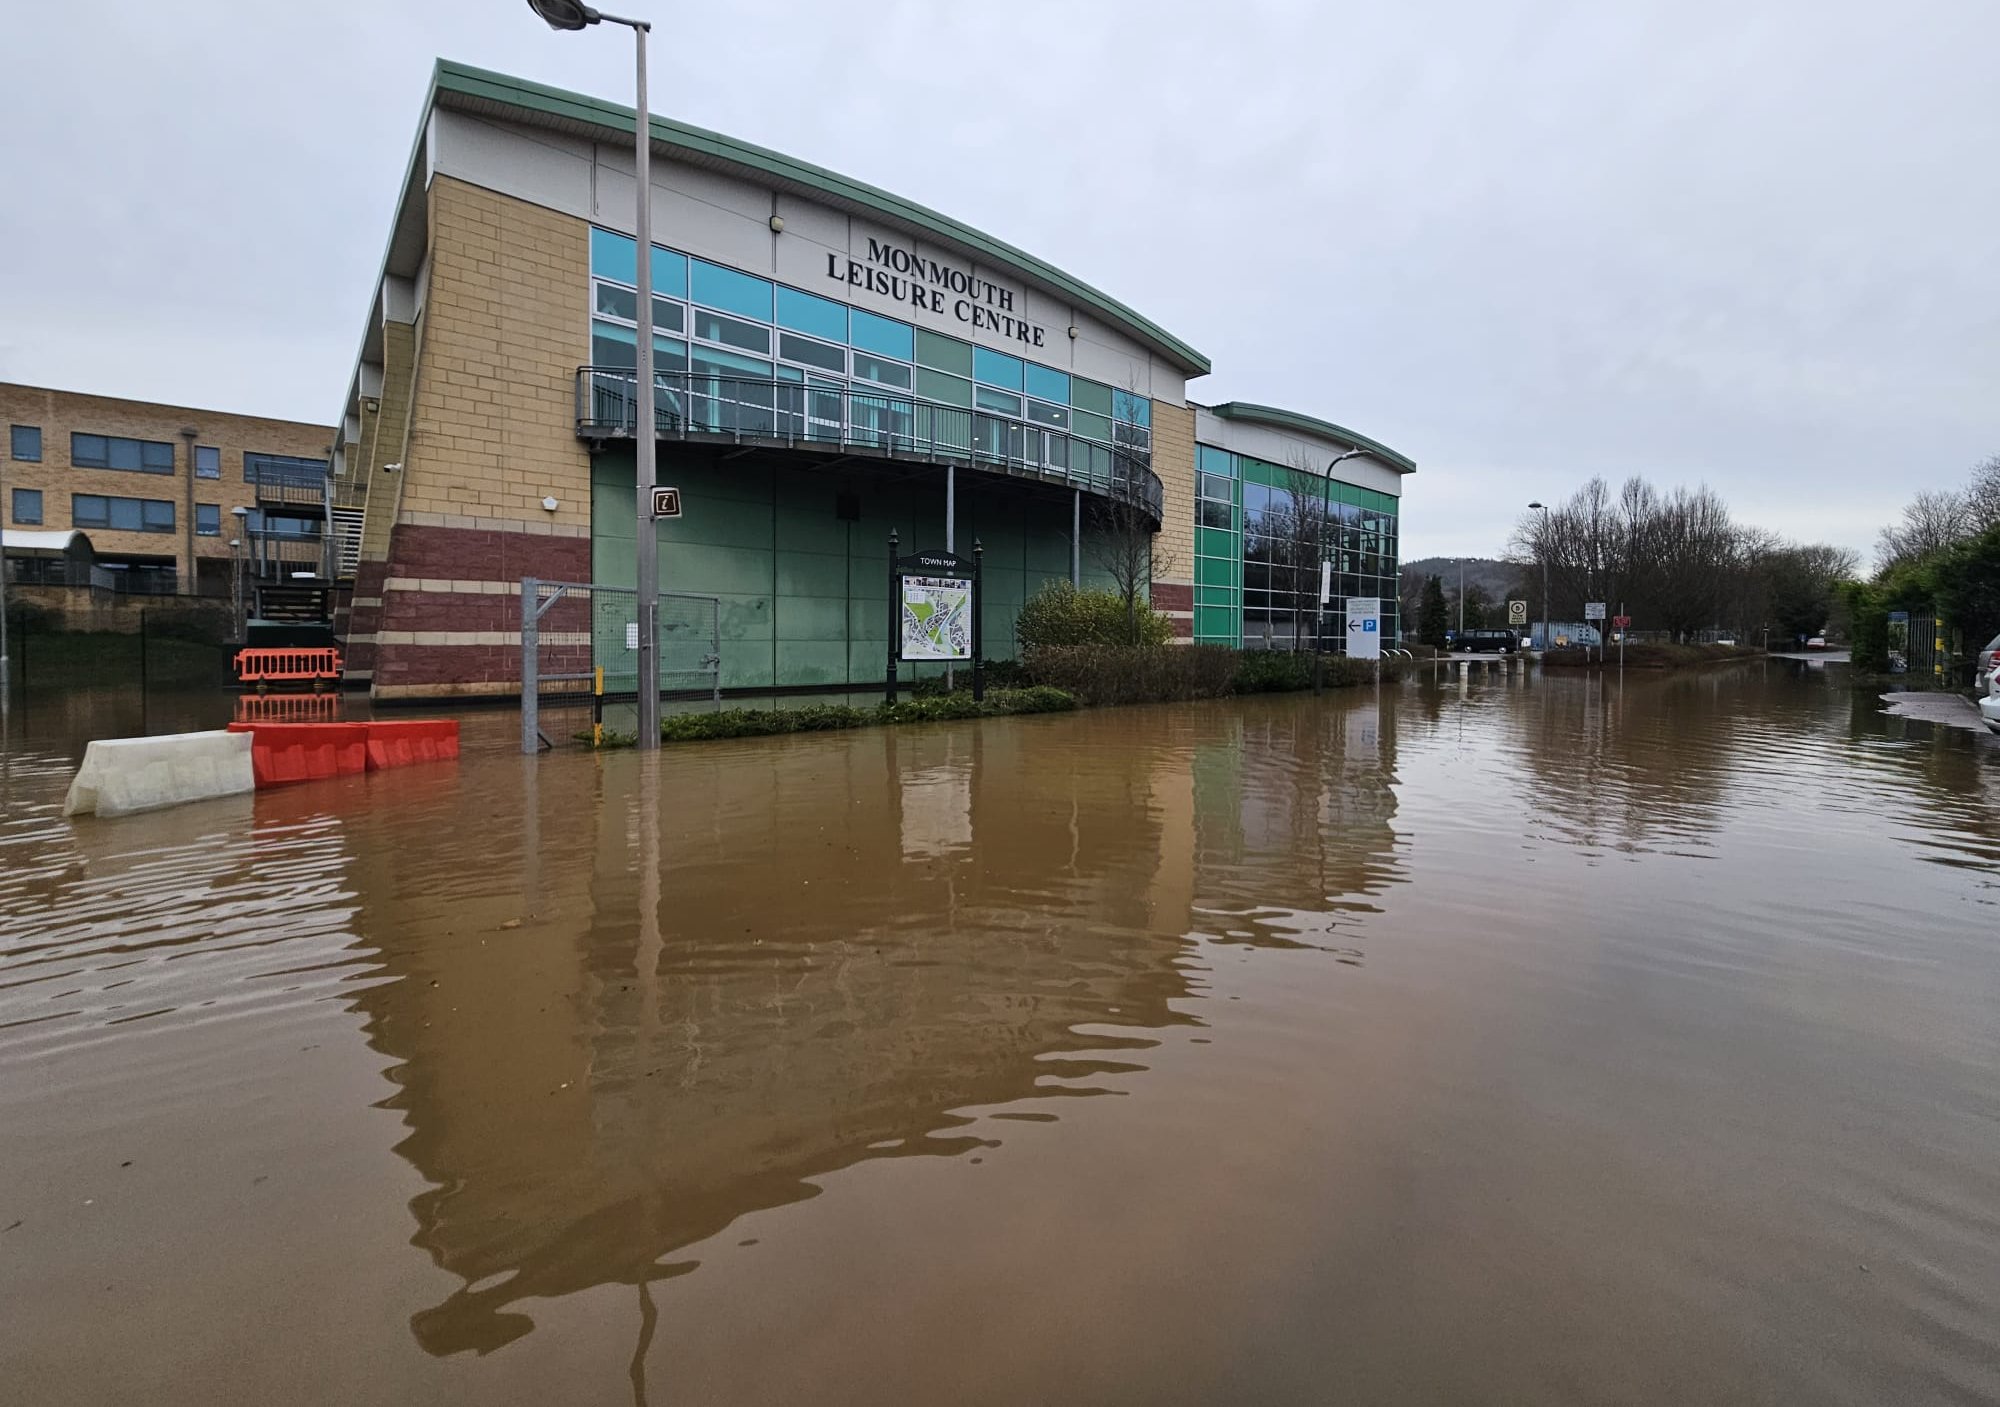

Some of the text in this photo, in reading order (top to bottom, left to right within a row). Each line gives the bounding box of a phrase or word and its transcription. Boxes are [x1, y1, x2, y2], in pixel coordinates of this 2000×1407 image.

[867, 237, 1014, 312] MONMOUTH
[827, 252, 1046, 348] LEISURE CENTRE
[920, 557, 957, 567] TOWN MAP
[1366, 620, 1374, 631] P
